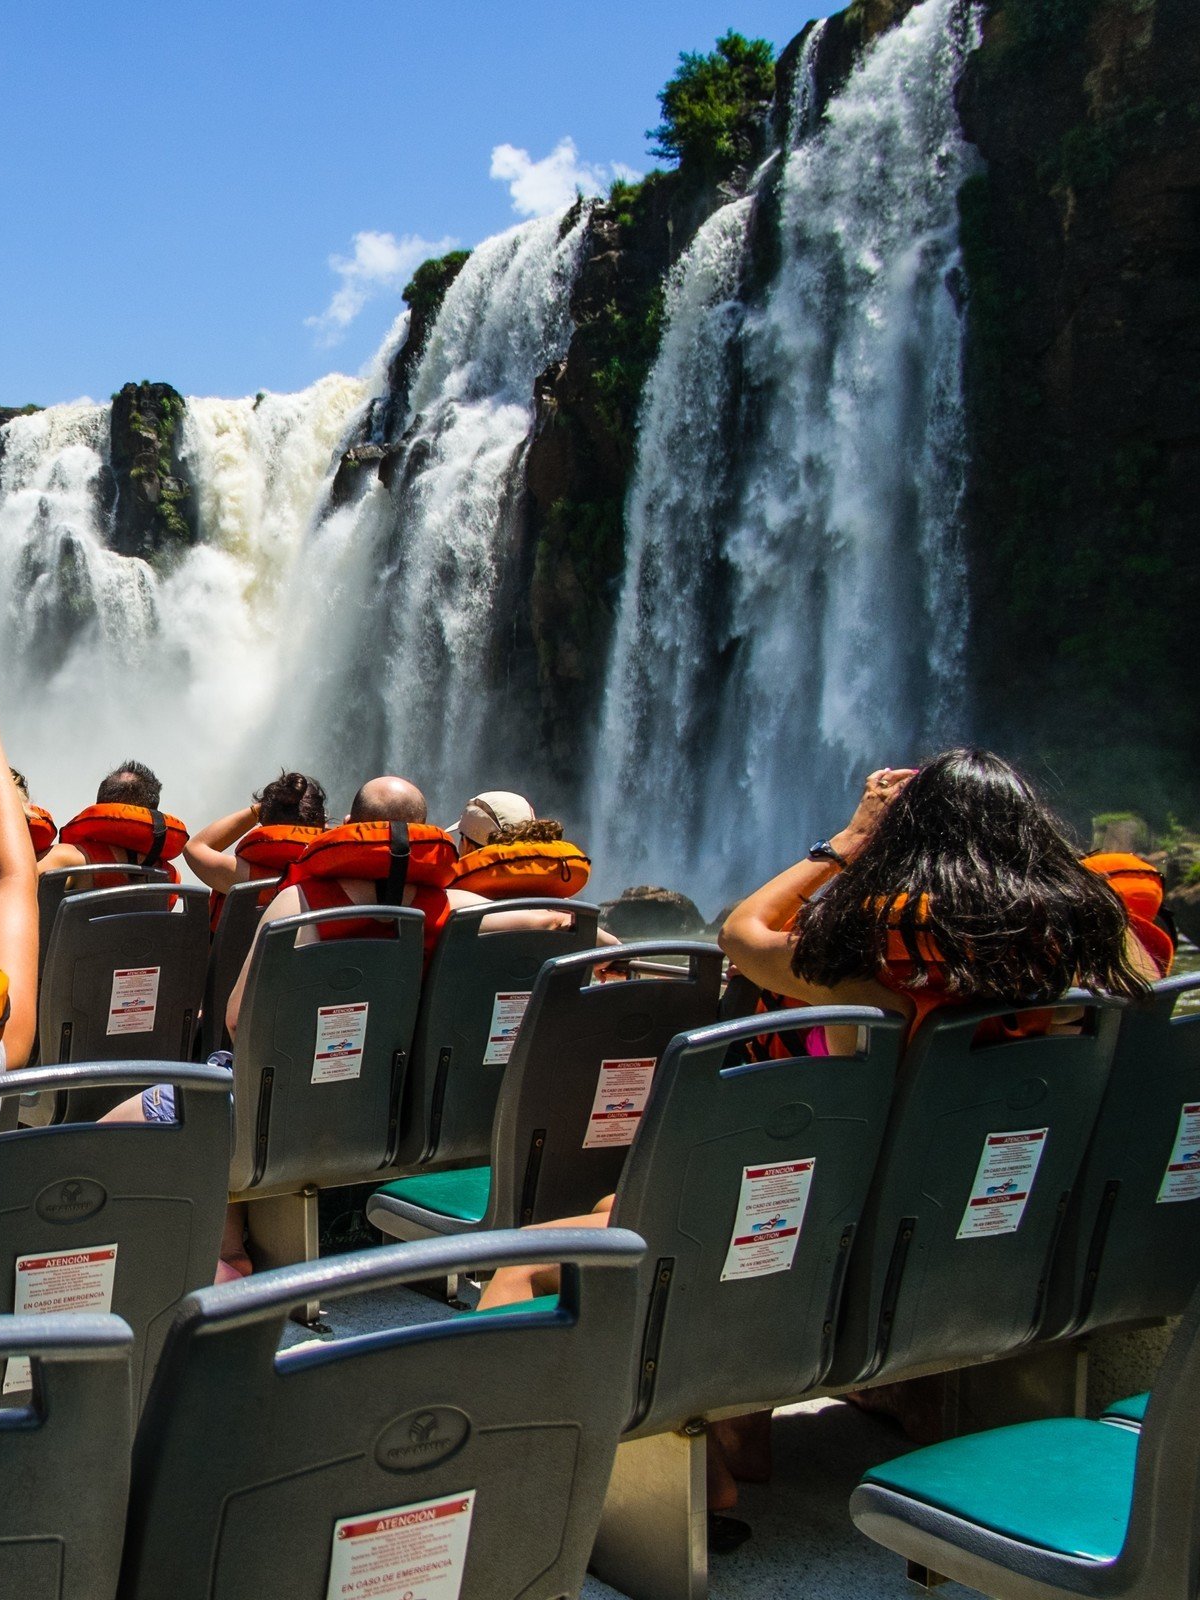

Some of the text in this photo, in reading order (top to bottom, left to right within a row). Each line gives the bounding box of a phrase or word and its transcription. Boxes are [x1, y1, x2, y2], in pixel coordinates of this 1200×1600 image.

[45, 1254, 90, 1267] ATENCIÓN
[23, 1302, 33, 1310] EN
[33, 1299, 52, 1308] CASO
[63, 1291, 105, 1303] EMERGENCIA
[376, 1509, 437, 1532] ATENCIÓN
[341, 1582, 355, 1594] EN
[355, 1576, 381, 1590] CASO
[383, 1572, 395, 1583] DE
[396, 1559, 453, 1578] EMERGENCIA
